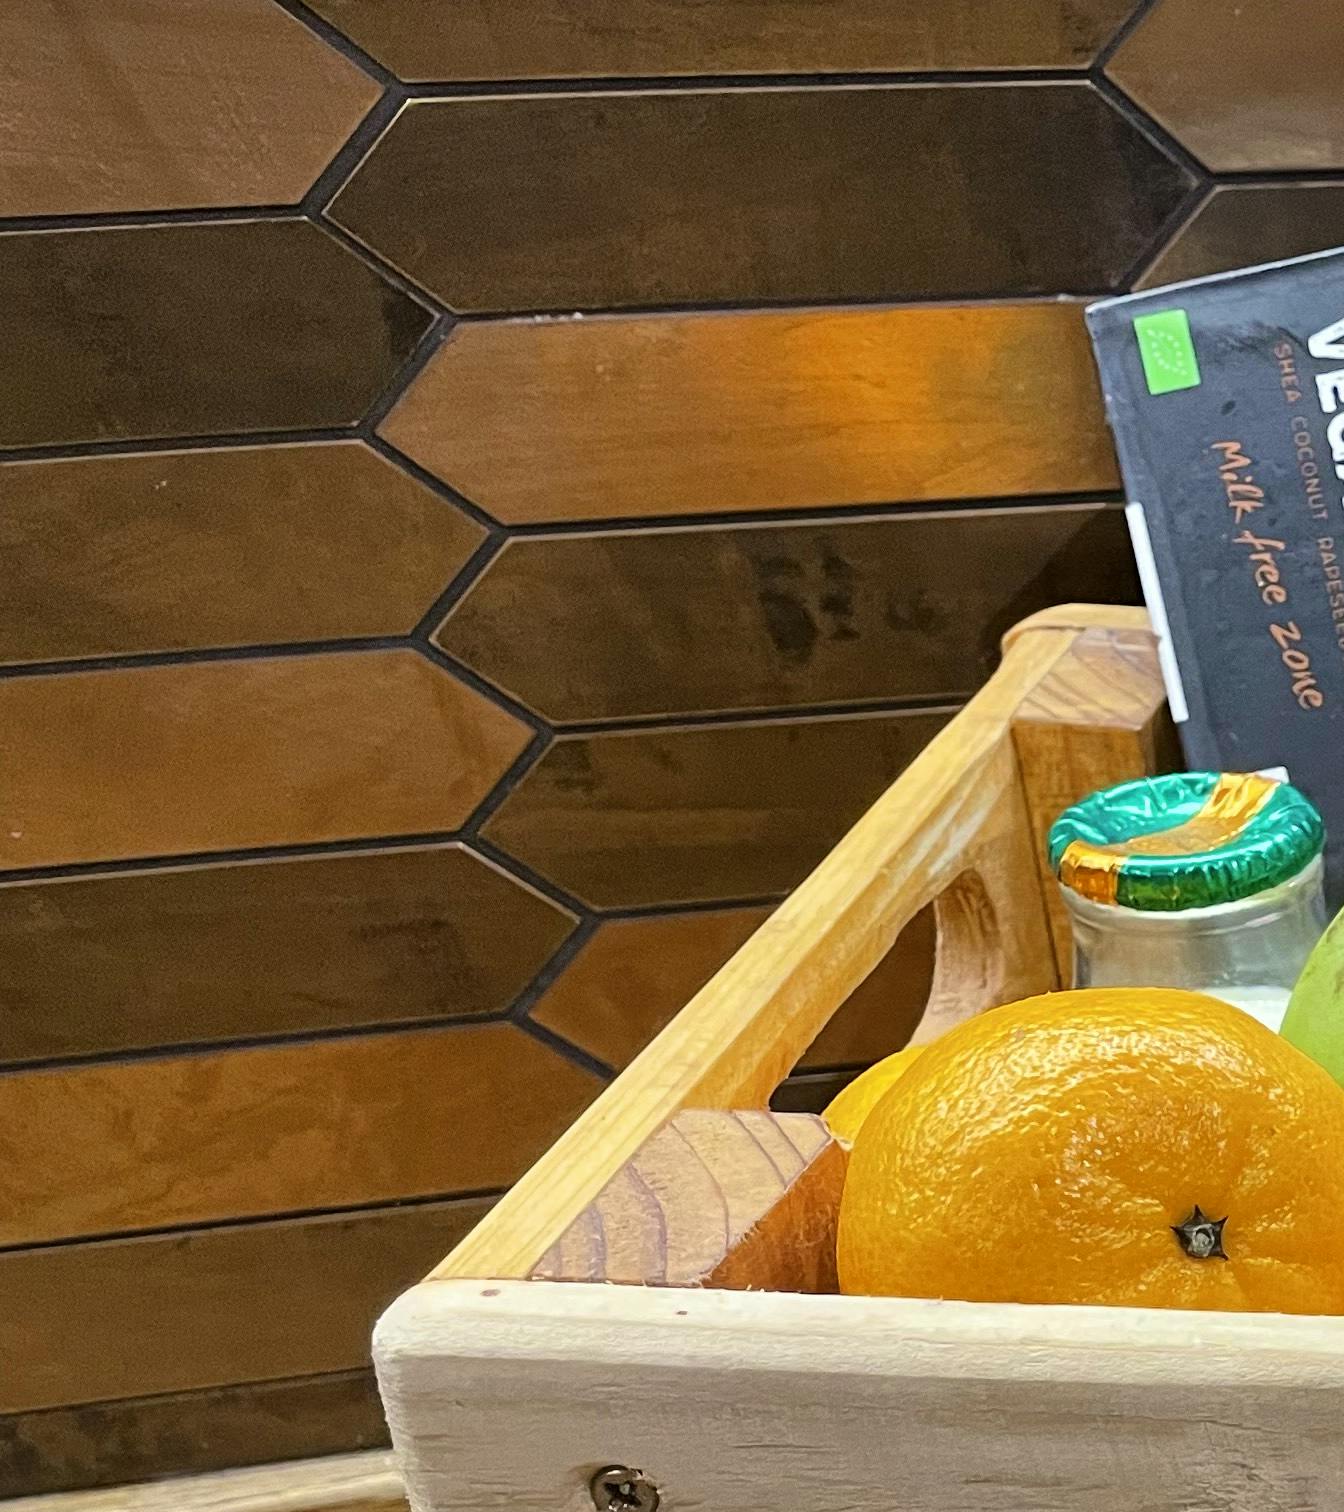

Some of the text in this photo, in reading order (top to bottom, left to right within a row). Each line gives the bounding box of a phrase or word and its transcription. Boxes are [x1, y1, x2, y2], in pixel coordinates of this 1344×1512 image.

[1273, 340, 1302, 406] SHEA
[1291, 416, 1328, 521] COCONUT
[1211, 440, 1324, 710] Milk free zone
